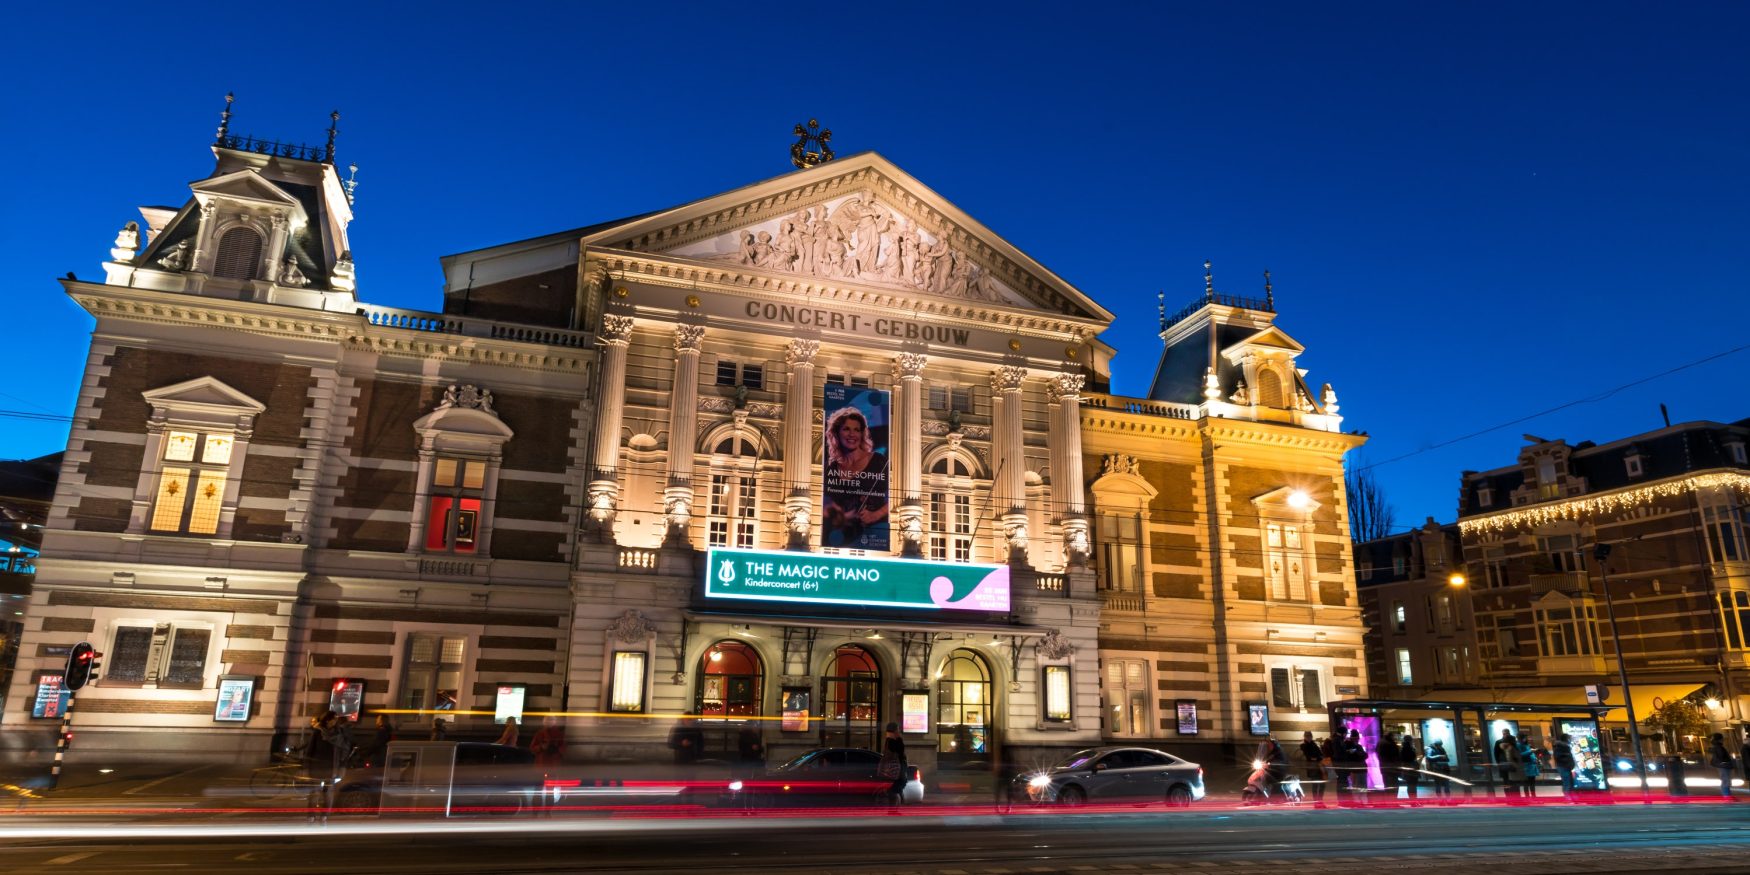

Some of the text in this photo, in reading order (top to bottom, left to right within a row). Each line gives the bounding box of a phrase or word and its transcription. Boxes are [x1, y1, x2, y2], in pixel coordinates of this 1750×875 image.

[745, 300, 970, 346] CONCERT-GEBOUW
[827, 469, 886, 481] ANNE-SOPHIE
[827, 479, 861, 487] MUTTER
[745, 561, 880, 582] THE MAGIC PIANO
[744, 578, 819, 591] Kinderconcert (6+)
